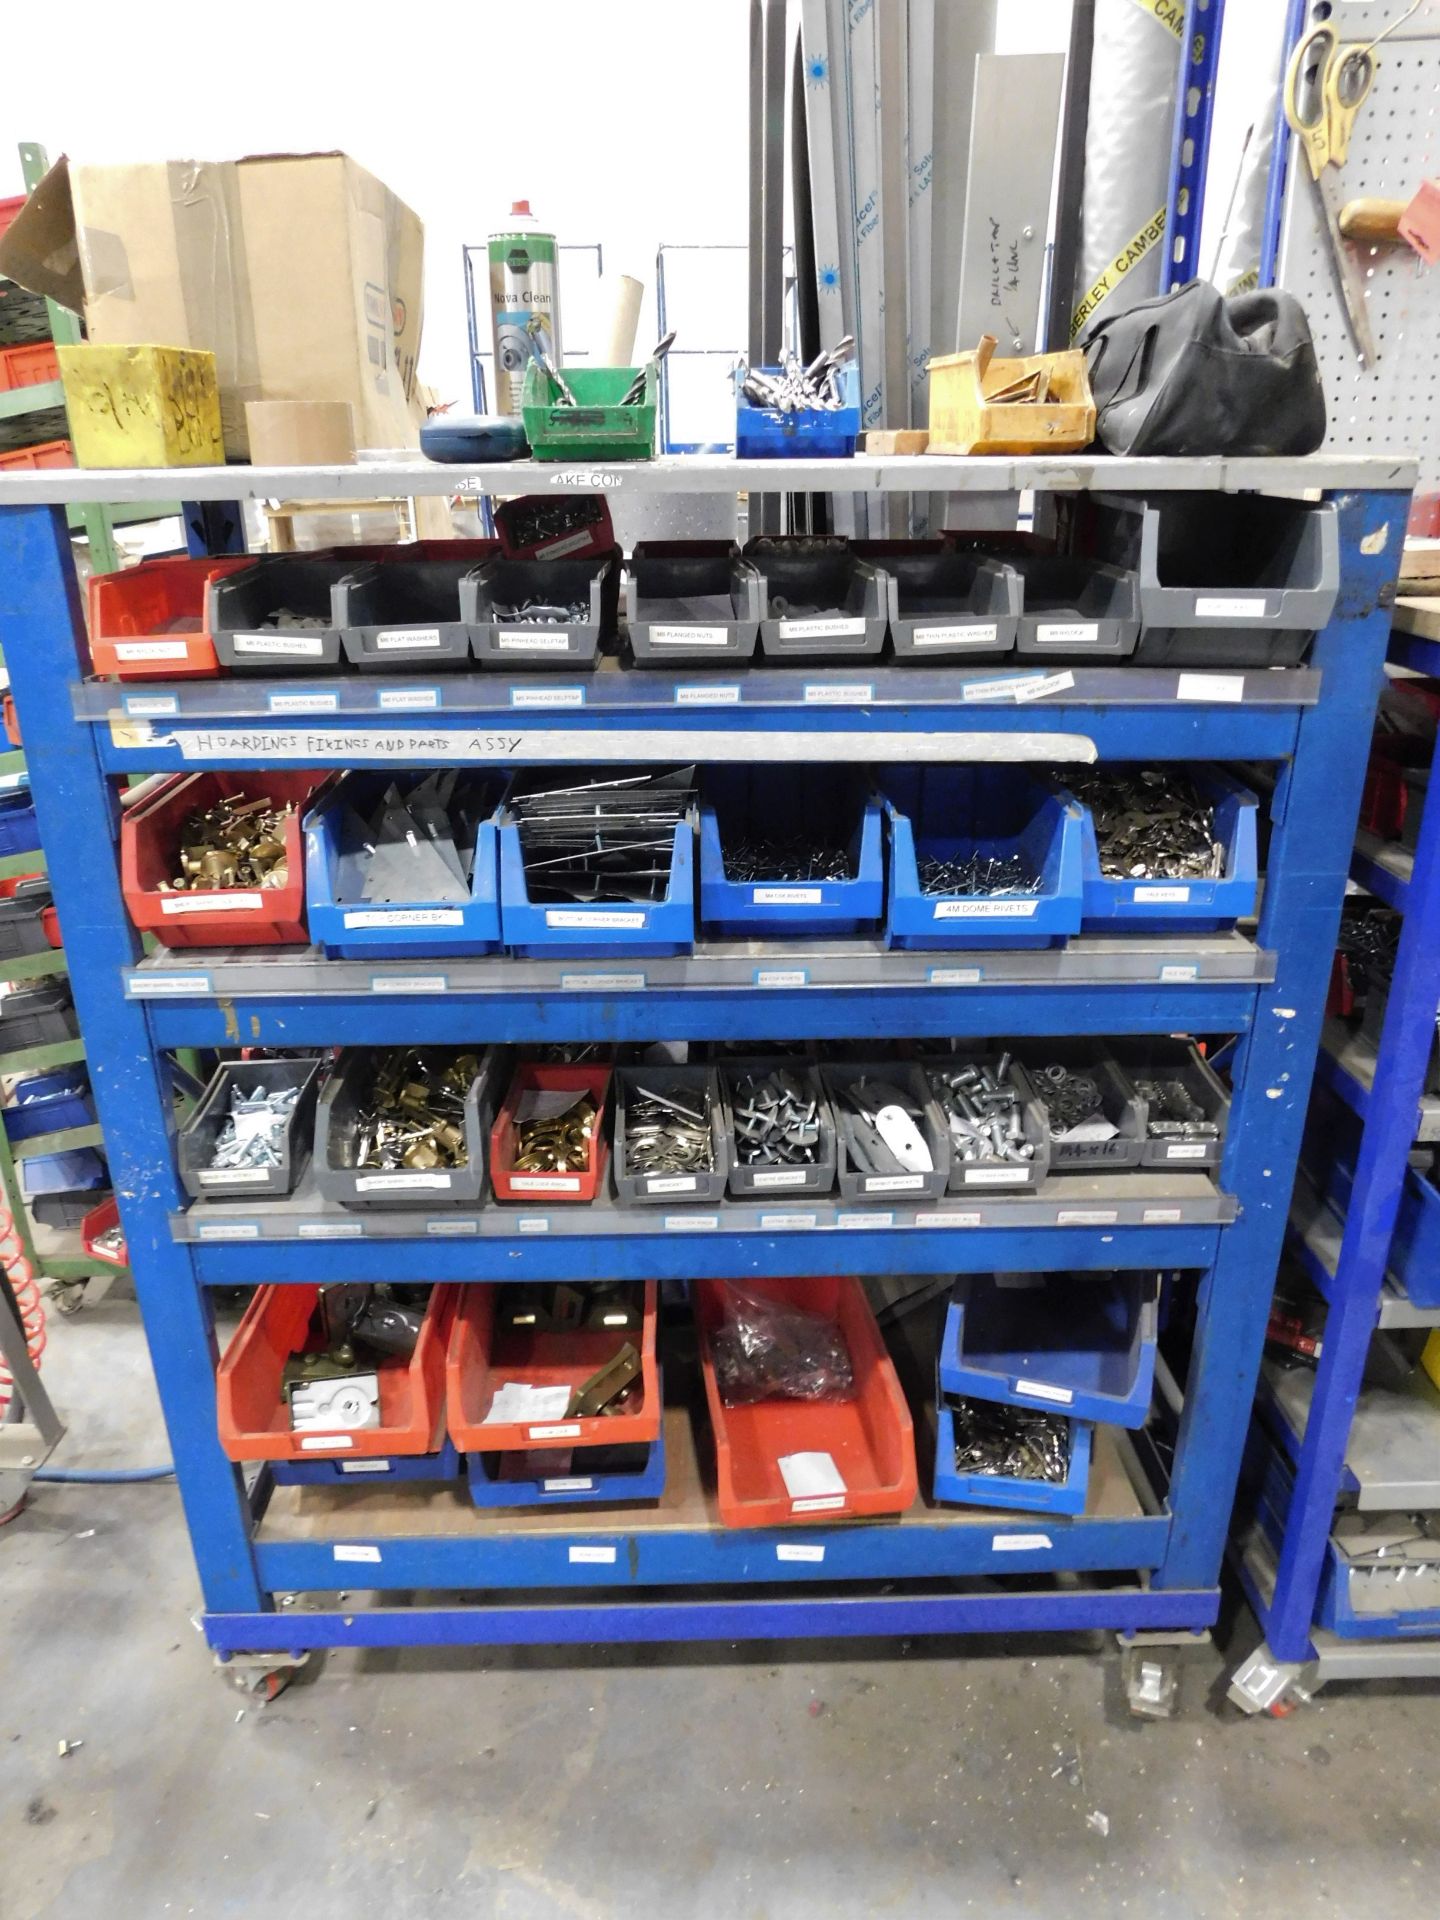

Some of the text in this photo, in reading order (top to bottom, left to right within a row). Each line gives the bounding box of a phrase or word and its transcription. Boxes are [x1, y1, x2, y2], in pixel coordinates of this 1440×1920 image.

[1069, 208, 1168, 338] BERLEY CAMBE
[494, 291, 552, 304] Nova Clean
[197, 735, 297, 751] HOARDINGS
[375, 738, 404, 751] AND
[409, 738, 450, 750] PARTS
[946, 904, 1028, 913] 4M DOME RIVETS
